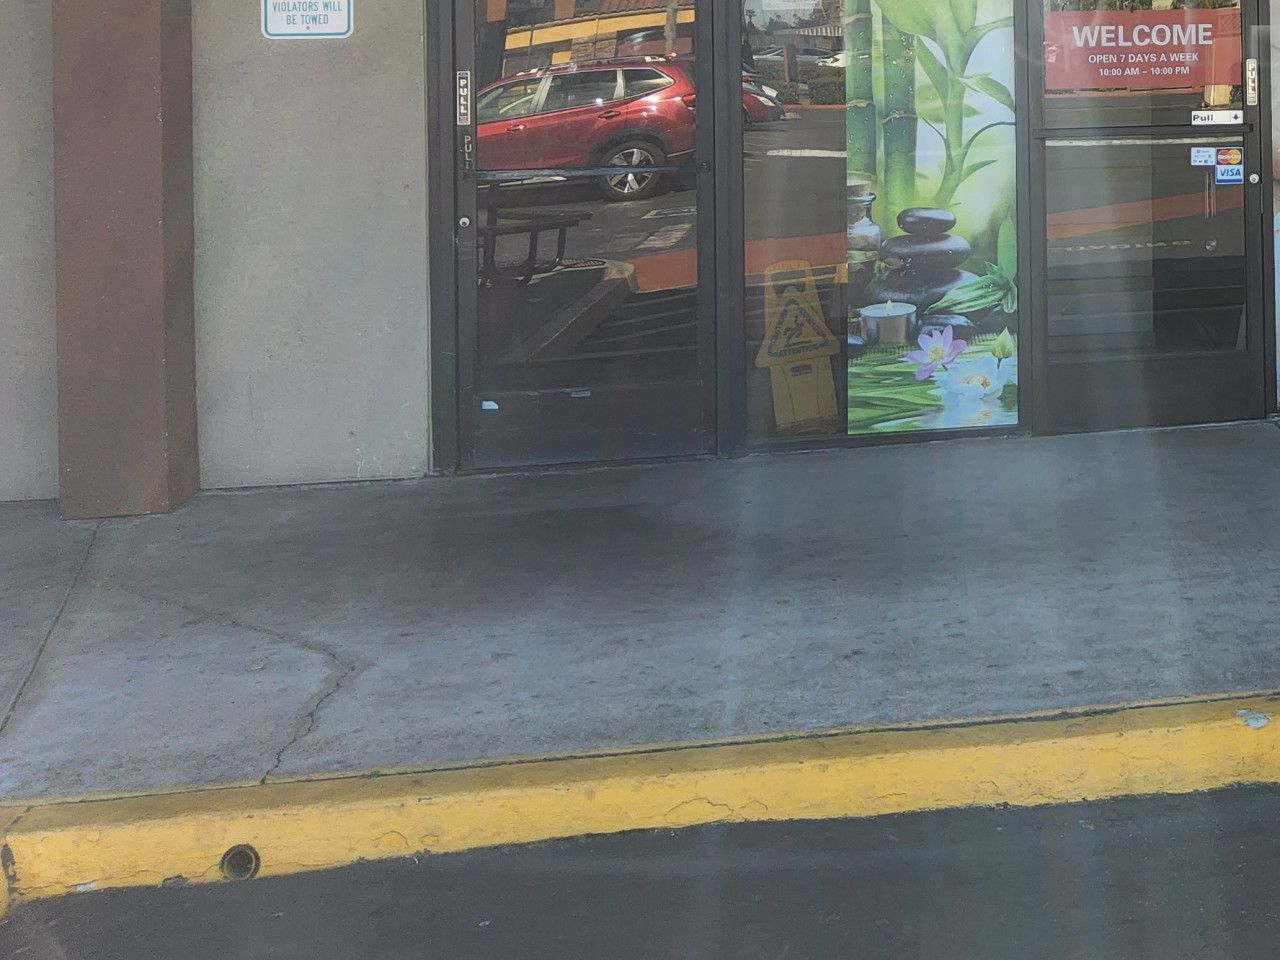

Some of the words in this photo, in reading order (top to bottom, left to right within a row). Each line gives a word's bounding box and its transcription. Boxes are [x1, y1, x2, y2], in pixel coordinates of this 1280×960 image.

[272, 1, 319, 12] VIOLATORS
[323, 1, 343, 11] WILL
[286, 14, 297, 25] BE
[301, 14, 329, 25] TOWED
[1072, 23, 1213, 48] WELCOME
[1088, 54, 1117, 64] OPEN
[1120, 54, 1126, 63] 7
[1128, 53, 1157, 62] DAYS
[1159, 53, 1167, 61] A
[1170, 52, 1199, 62] WEEK
[1099, 68, 1122, 76] 10:00
[1124, 68, 1140, 76] AM
[1150, 67, 1173, 75] 10:00
[460, 79, 468, 114] PULL
[1193, 114, 1213, 122] Pull
[1220, 168, 1241, 177] VISA
